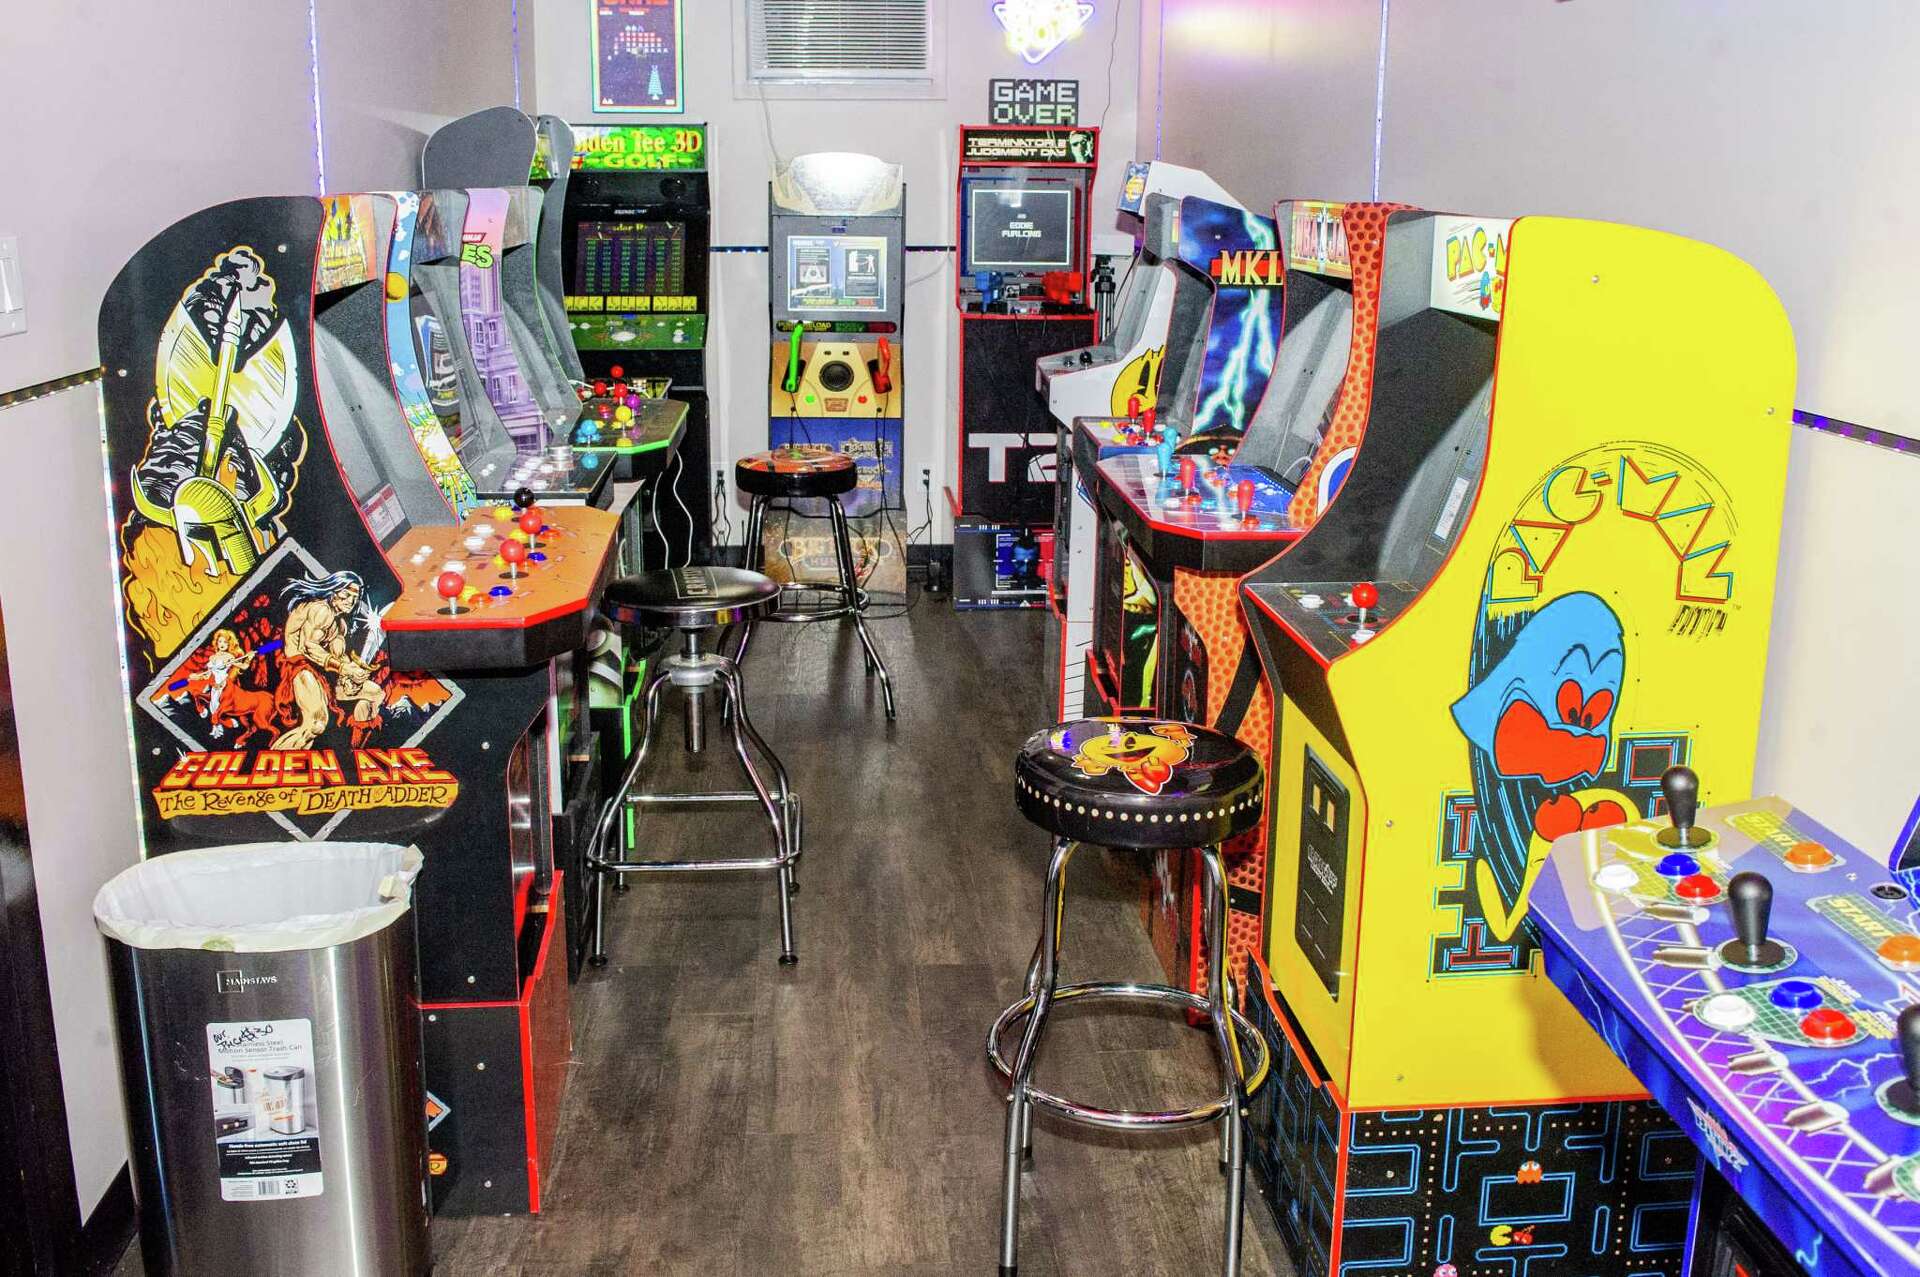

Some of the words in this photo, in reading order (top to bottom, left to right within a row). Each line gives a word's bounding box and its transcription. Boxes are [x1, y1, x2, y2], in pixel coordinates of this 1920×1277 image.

[993, 81, 1076, 102] GAME
[993, 103, 1076, 124] OVER
[670, 129, 702, 153] 3D
[461, 243, 495, 269] ES
[1218, 250, 1284, 286] MKI
[1485, 454, 1735, 606] PAC-MAN
[158, 749, 347, 790] GOLDEN
[352, 747, 459, 786] AXE
[161, 790, 196, 813] The
[202, 789, 276, 812] Revenge
[278, 788, 298, 801] of
[306, 788, 371, 812] DEATH
[379, 785, 448, 804] ADDER
[1828, 897, 1897, 938] START
